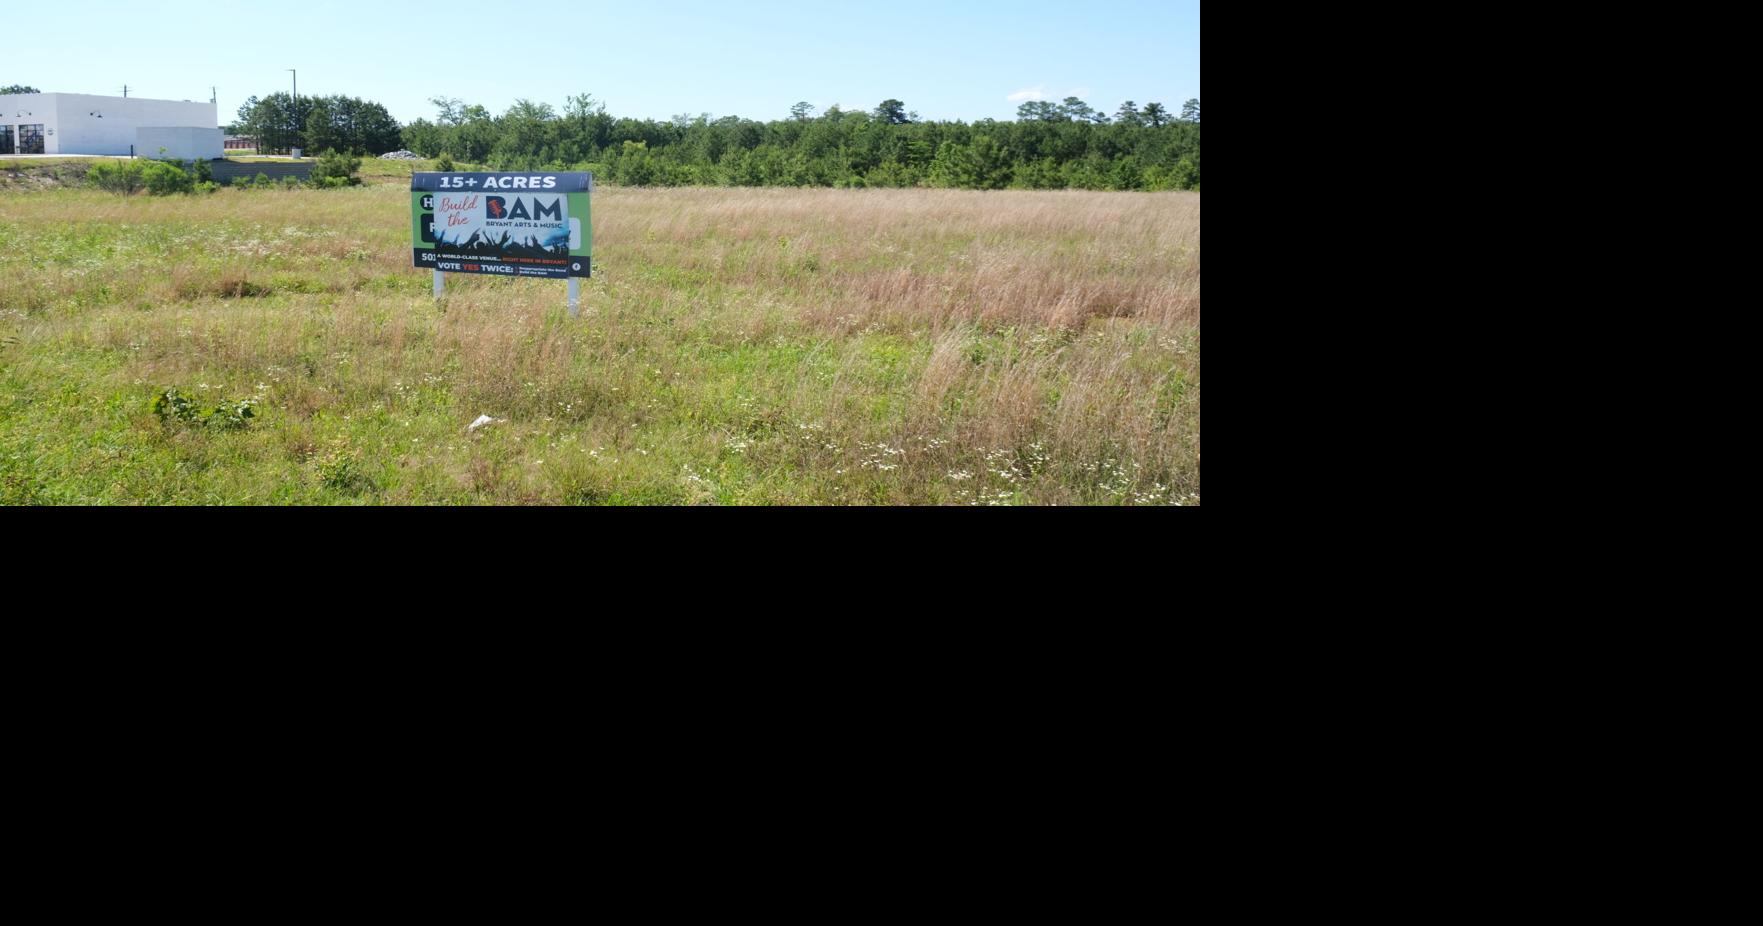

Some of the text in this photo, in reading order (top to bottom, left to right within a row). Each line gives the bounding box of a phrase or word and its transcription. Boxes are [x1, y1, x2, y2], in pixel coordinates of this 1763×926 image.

[439, 176, 557, 189] 15+ ACRES
[439, 194, 479, 212] Build
[486, 195, 562, 221] BAM
[447, 211, 470, 227] the
[437, 262, 514, 273] VOTE YES TWICE:
